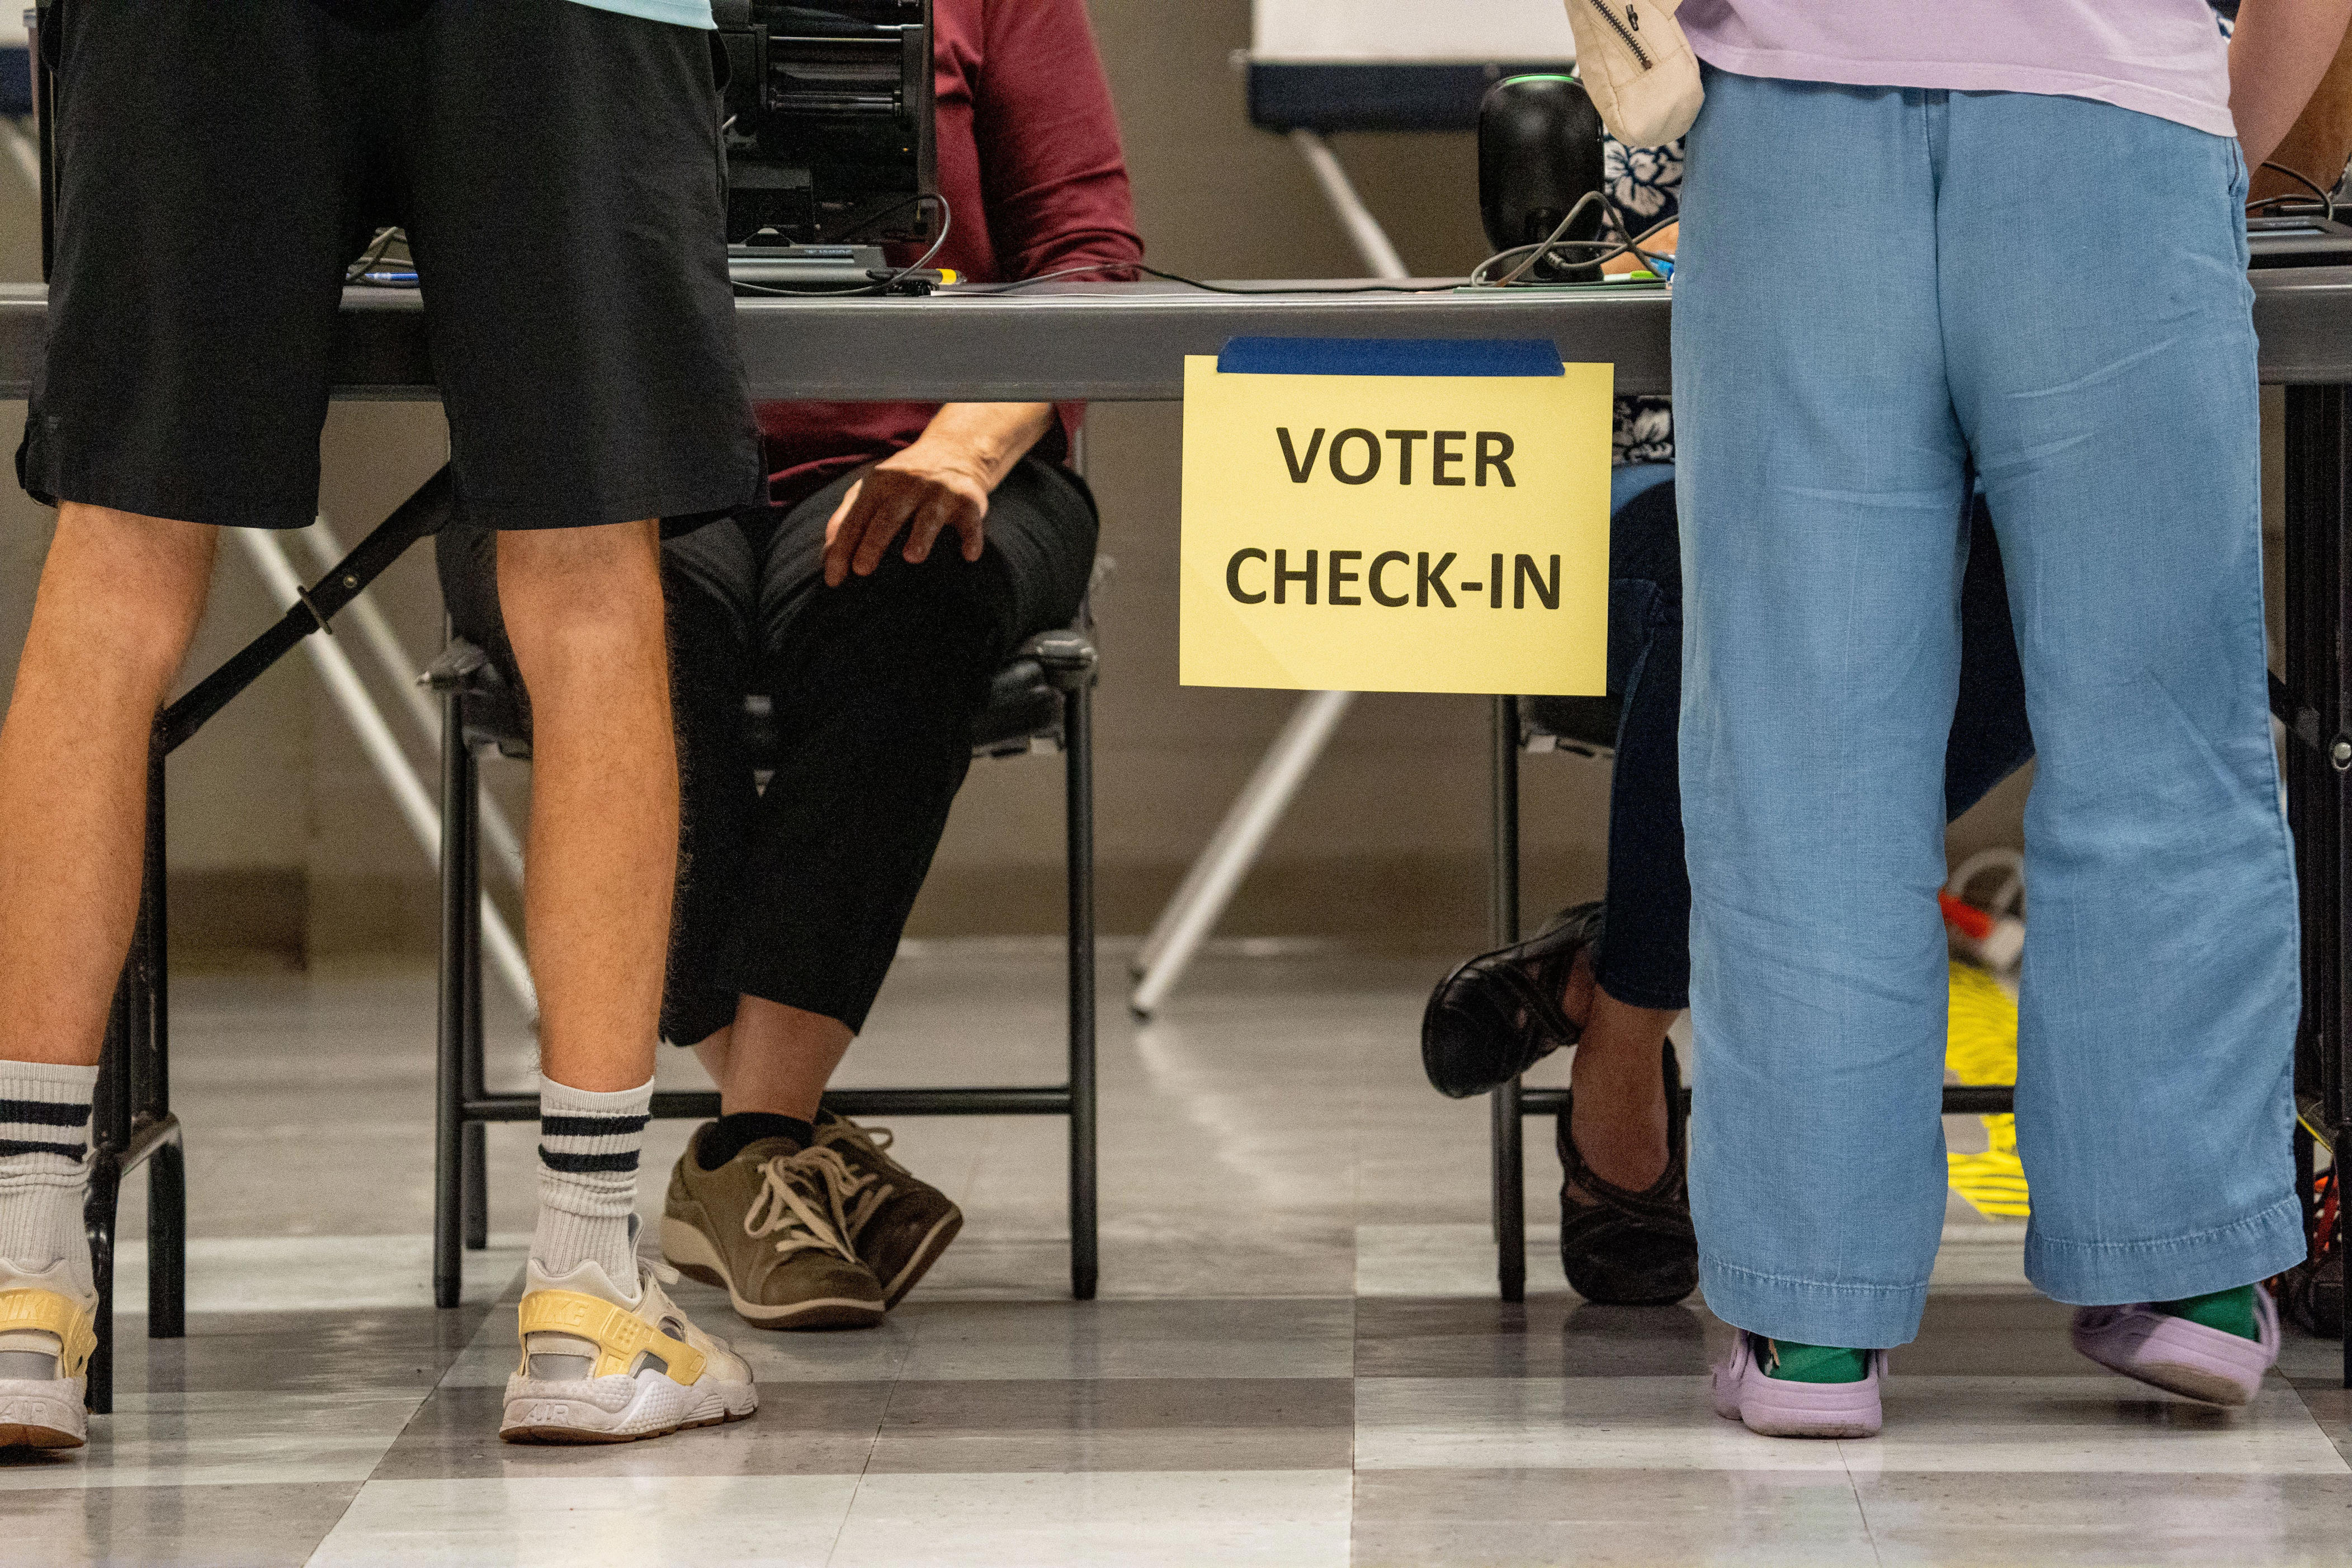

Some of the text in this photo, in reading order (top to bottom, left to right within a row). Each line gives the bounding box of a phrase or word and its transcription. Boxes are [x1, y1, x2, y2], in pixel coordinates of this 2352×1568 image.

[1276, 427, 1516, 487] VOTER
[1226, 547, 1561, 610] CHECK-IN
[518, 1403, 570, 1425] AIR
